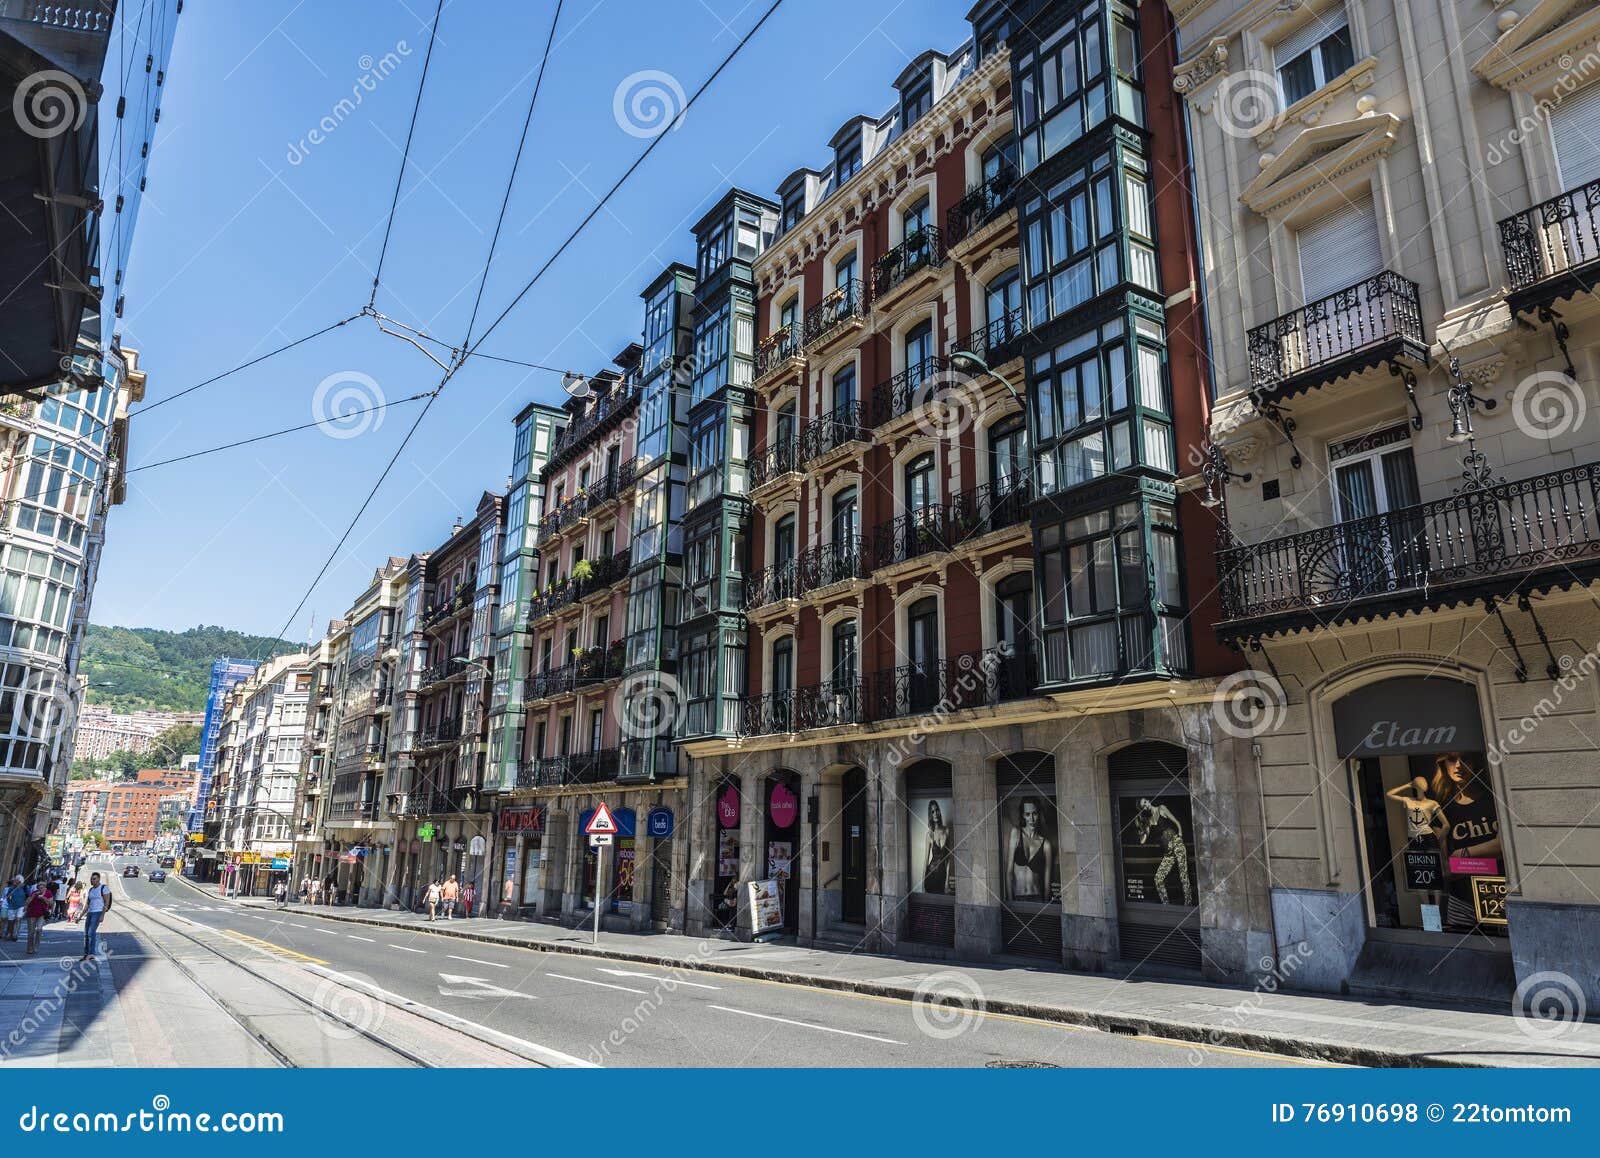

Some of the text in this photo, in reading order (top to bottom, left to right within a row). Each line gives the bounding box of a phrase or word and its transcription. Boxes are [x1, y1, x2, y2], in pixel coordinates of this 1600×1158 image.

[1363, 720, 1457, 749] Etam
[1407, 854, 1436, 865] BIKINI
[1414, 870, 1436, 884] 20€
